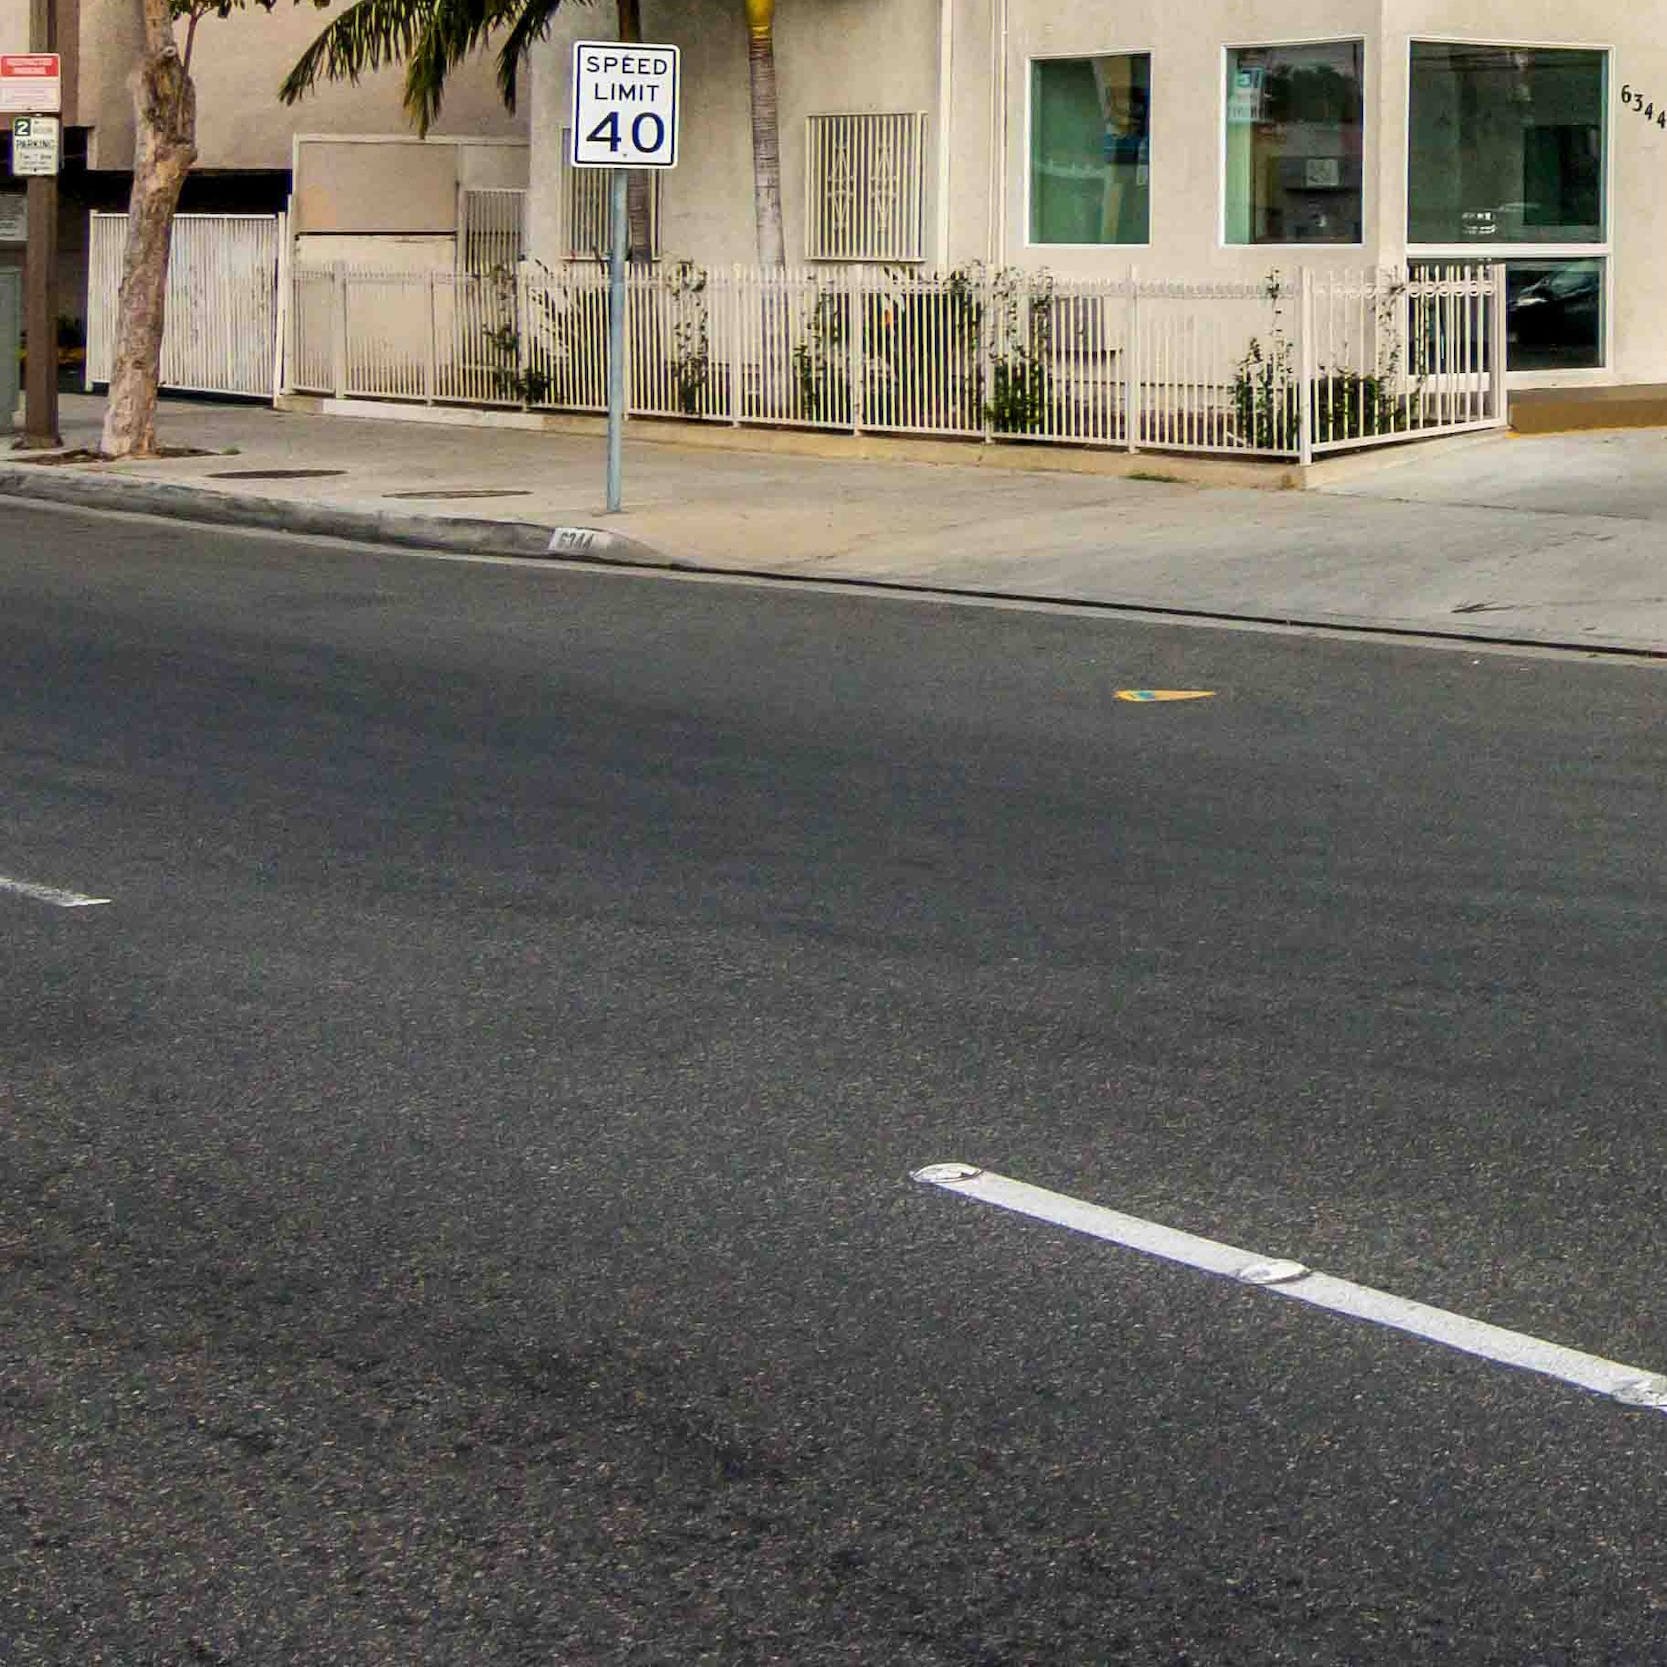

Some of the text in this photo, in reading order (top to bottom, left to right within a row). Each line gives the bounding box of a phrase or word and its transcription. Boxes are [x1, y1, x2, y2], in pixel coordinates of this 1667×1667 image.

[586, 55, 668, 75] SPEED
[594, 82, 660, 102] LIMIT
[1621, 84, 1667, 130] 6344
[17, 120, 29, 135] 2
[586, 111, 665, 153] 40
